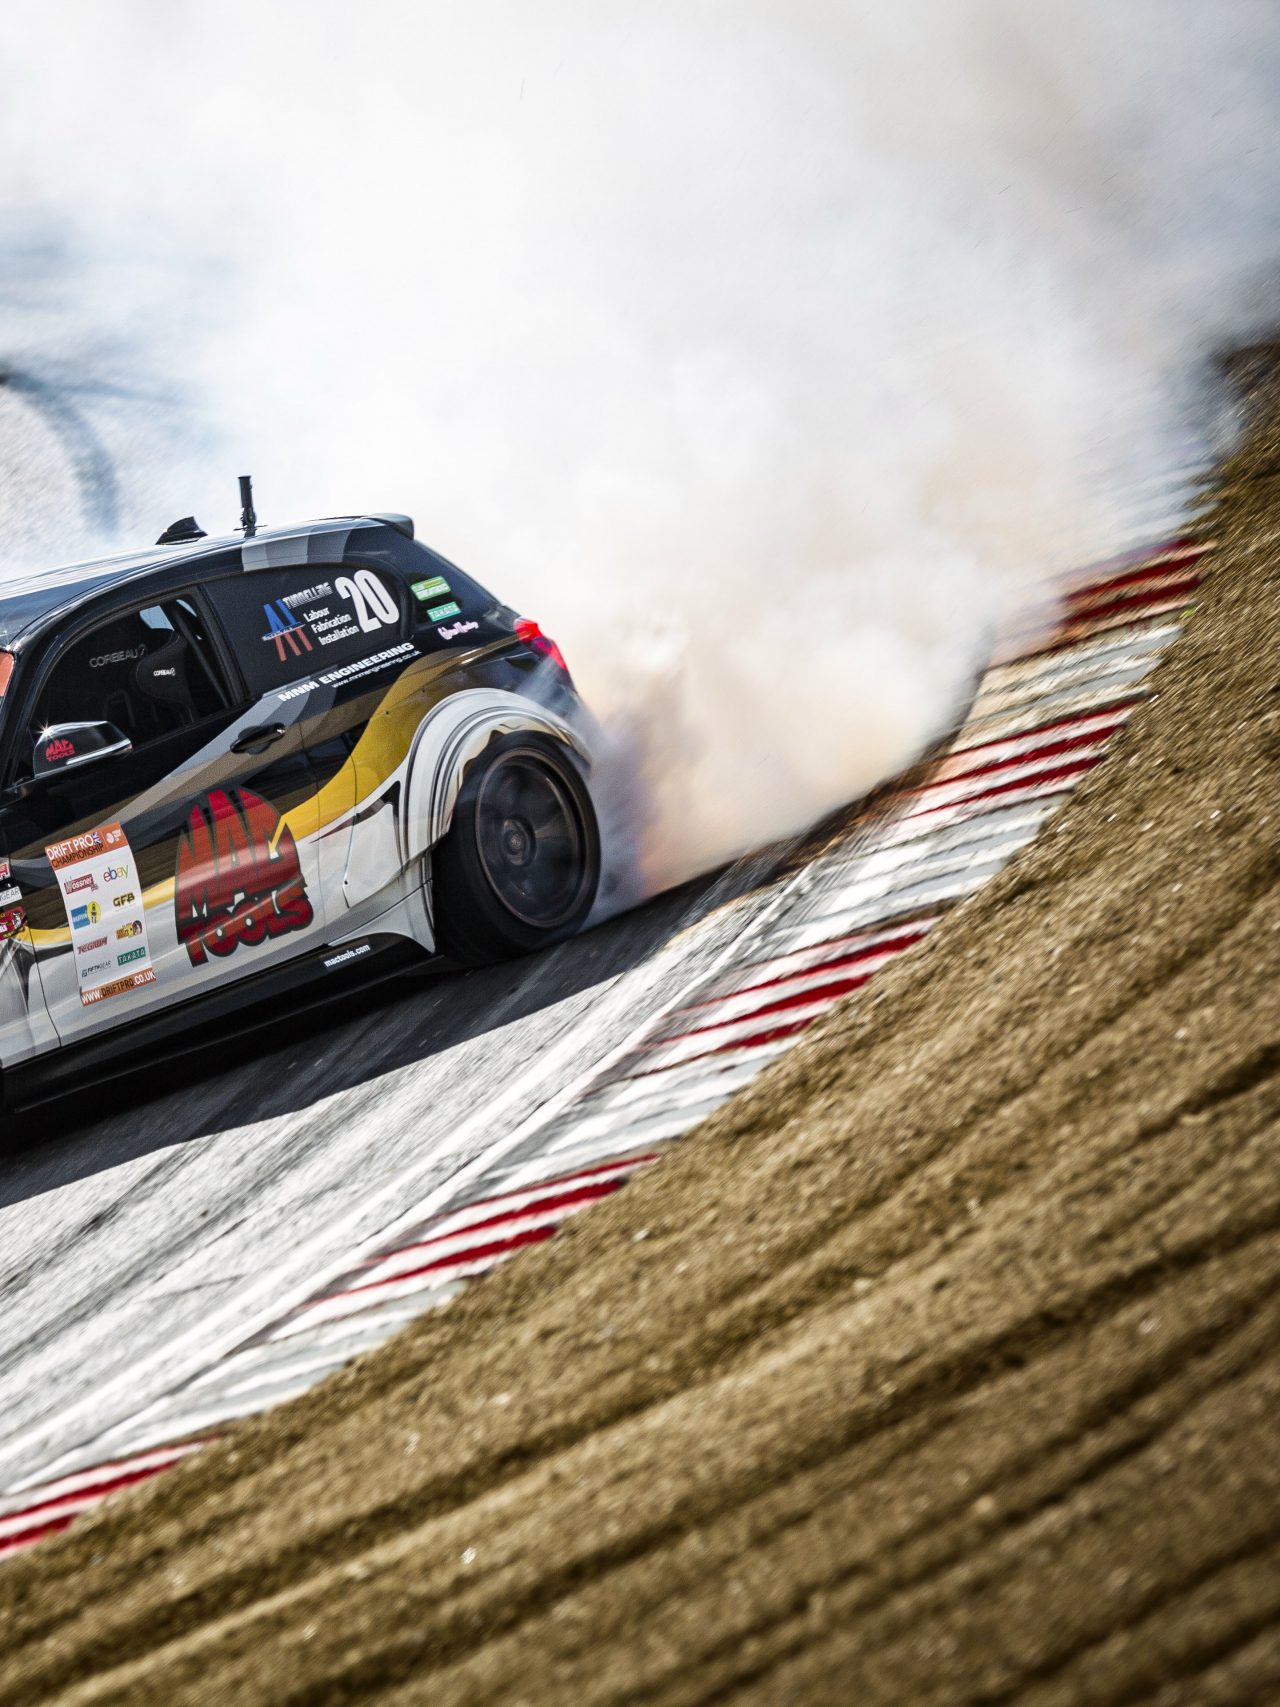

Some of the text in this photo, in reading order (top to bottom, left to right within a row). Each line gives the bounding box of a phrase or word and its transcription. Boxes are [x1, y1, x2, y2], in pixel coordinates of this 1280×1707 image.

[335, 569, 399, 633] 20
[303, 607, 330, 622] Labour
[311, 614, 352, 633] Fabrication
[318, 625, 360, 645] Installation
[89, 649, 138, 668] CORBEAU
[278, 642, 415, 702] MNM ENGINEERING
[46, 739, 74, 756] MAC
[46, 841, 73, 860] DRIFT
[73, 834, 94, 851] PRO
[52, 844, 104, 867] CHAMPIONSHIP
[175, 784, 302, 924] MAC
[103, 865, 128, 882] ebay
[113, 893, 135, 907] GFB
[178, 882, 314, 968] TOOLS
[118, 949, 146, 965] TAKATA
[324, 944, 371, 967] mactools.com
[81, 970, 156, 1004] WWW.DRIFTPRO.CO.UK
